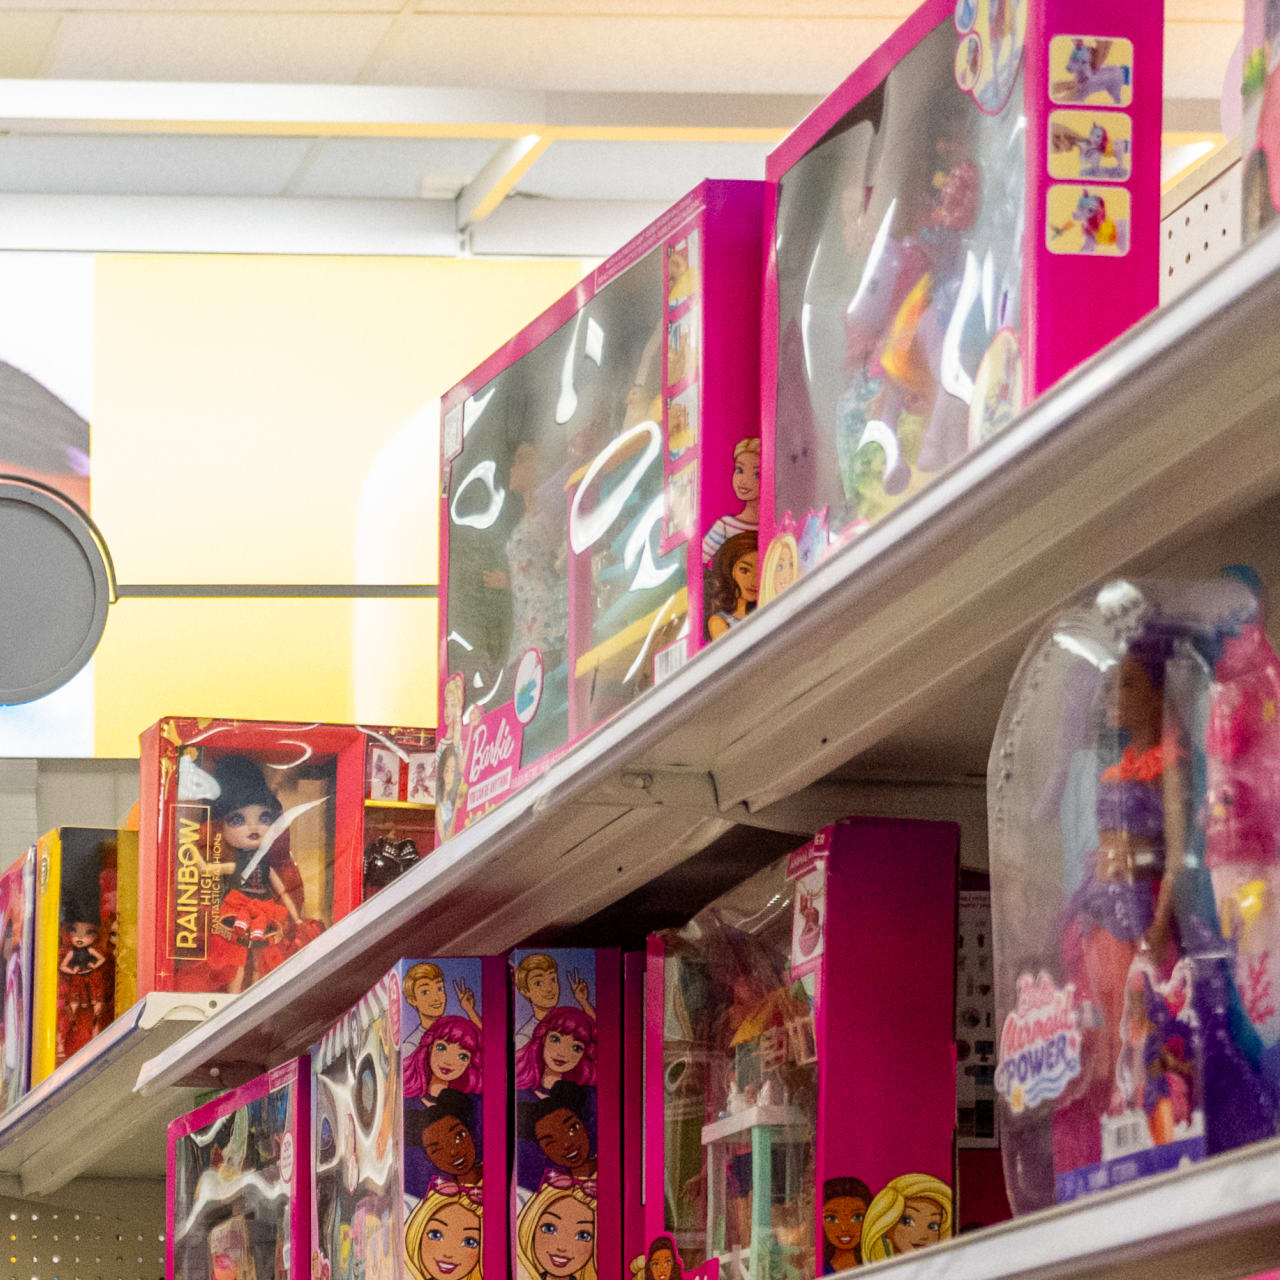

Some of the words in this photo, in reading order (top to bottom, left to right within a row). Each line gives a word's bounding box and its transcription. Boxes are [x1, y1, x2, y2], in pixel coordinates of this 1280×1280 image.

[468, 717, 515, 784] Barbie
[175, 817, 201, 949] RAINBOW
[1006, 1038, 1070, 1087] POWER
